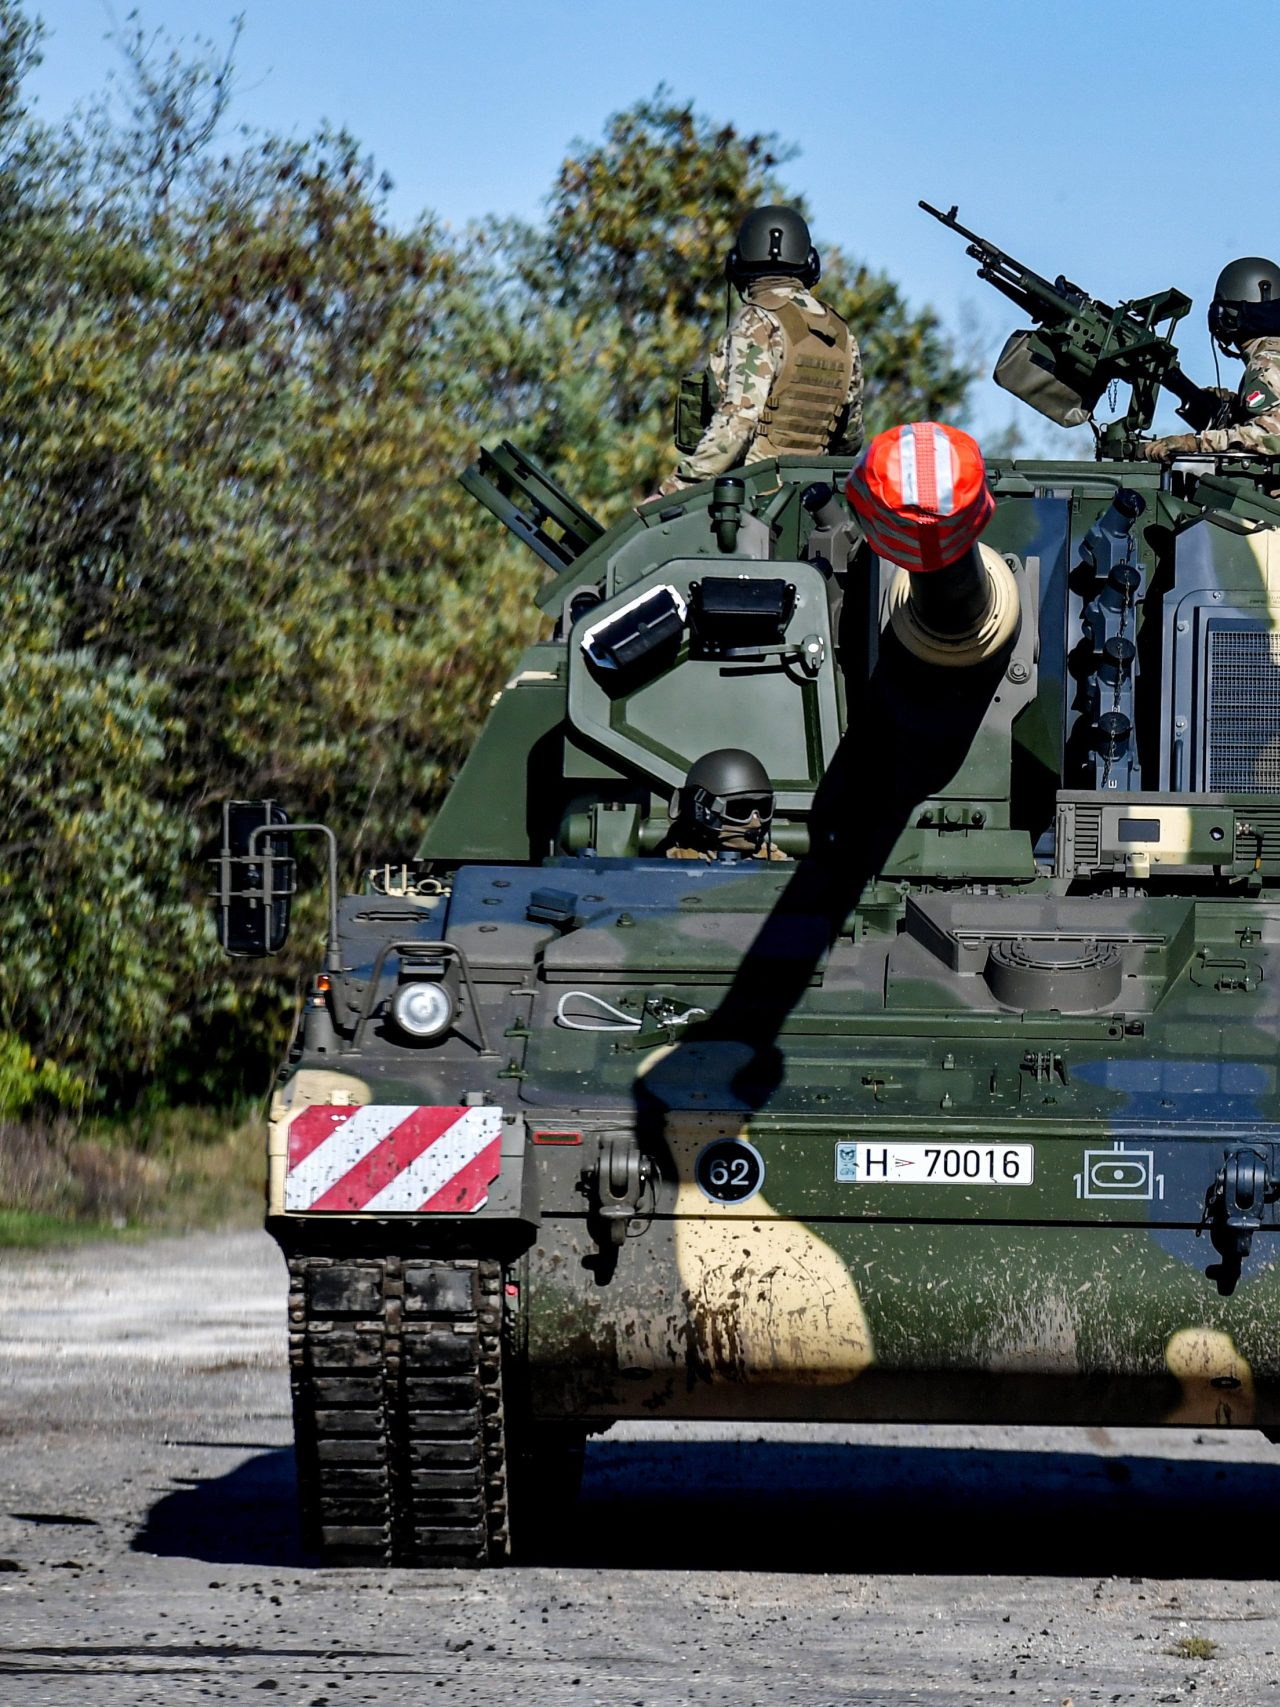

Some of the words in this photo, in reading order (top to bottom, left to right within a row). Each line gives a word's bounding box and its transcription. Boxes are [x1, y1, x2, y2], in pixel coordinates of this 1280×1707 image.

[709, 1158, 749, 1185] 62
[866, 1149, 888, 1177] H
[924, 1149, 1020, 1178] 70016
[1073, 1173, 1081, 1199] 1
[1155, 1174, 1165, 1200] 1
